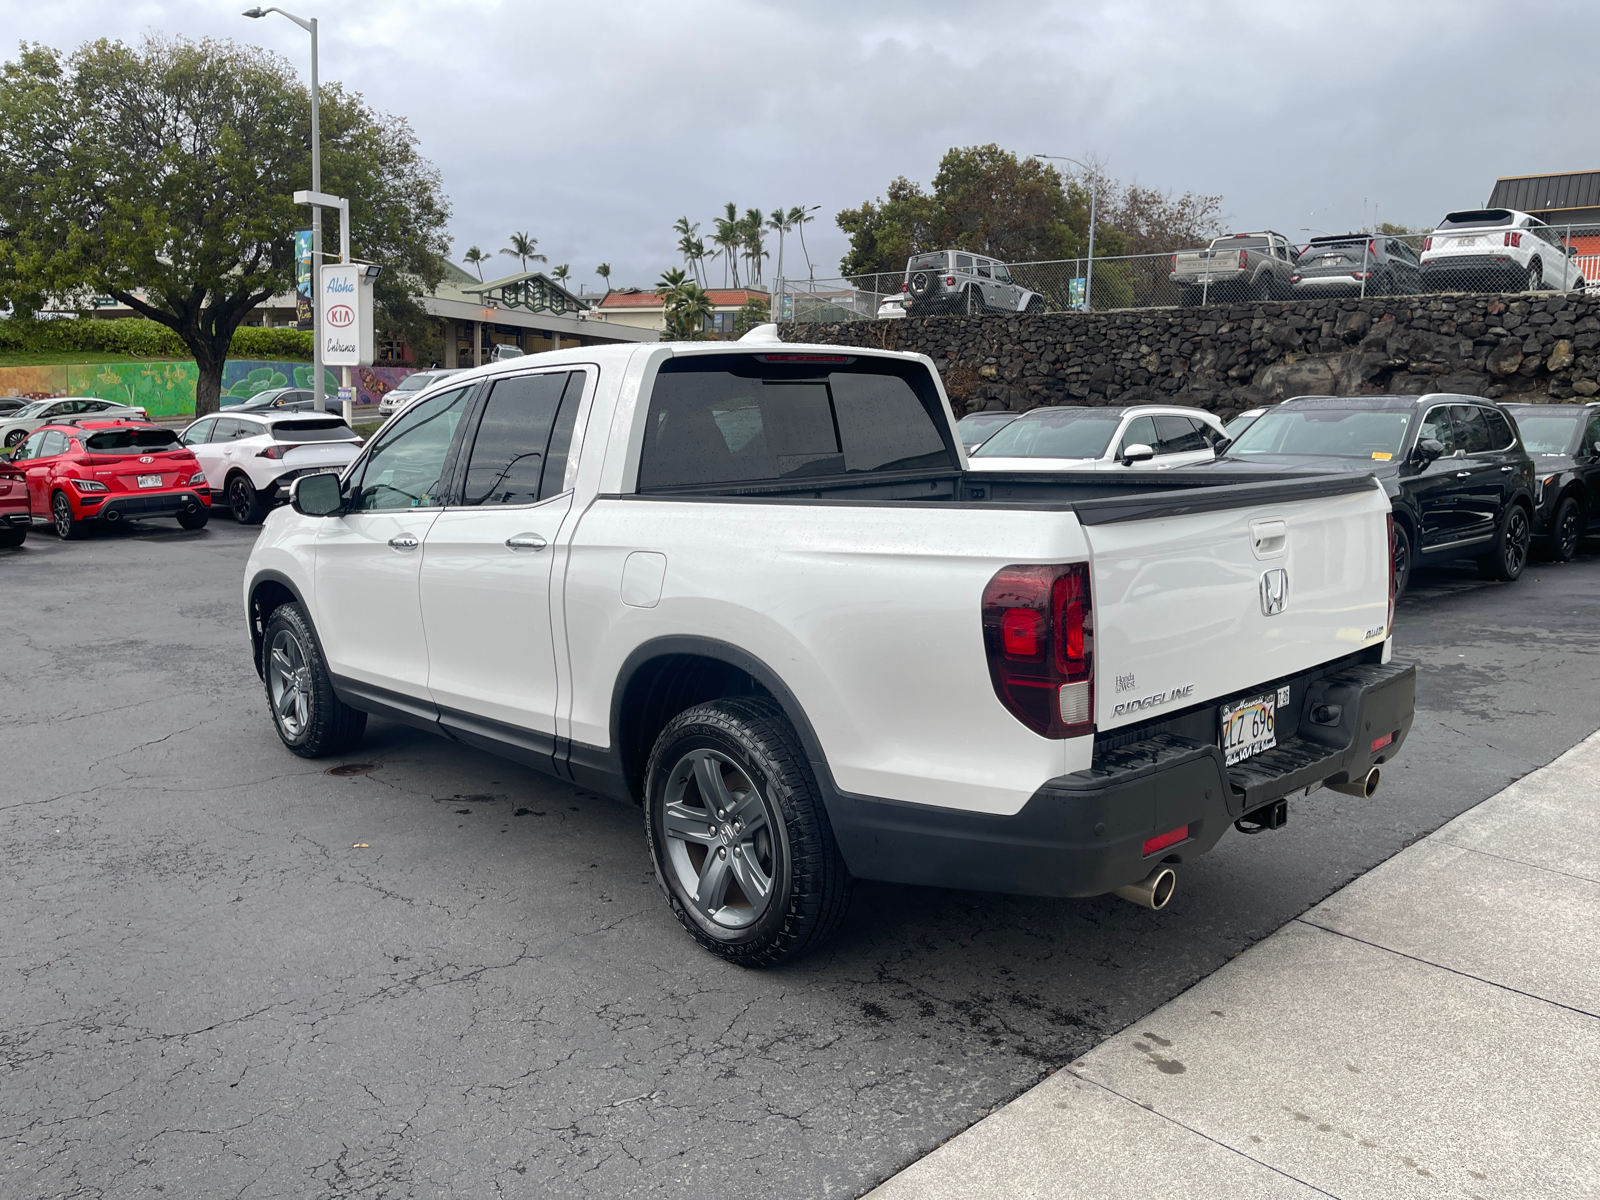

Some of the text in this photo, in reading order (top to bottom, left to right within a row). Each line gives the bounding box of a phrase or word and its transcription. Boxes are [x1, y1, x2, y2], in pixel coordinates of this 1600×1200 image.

[326, 277, 354, 293] Aloha
[332, 310, 350, 322] KIA
[327, 338, 356, 353] Entrance
[1115, 672, 1135, 686] Honda
[1119, 680, 1136, 691] West
[1110, 683, 1194, 719] RIDGELINE
[1235, 696, 1264, 711] Hawaii
[1252, 705, 1274, 739] 696
